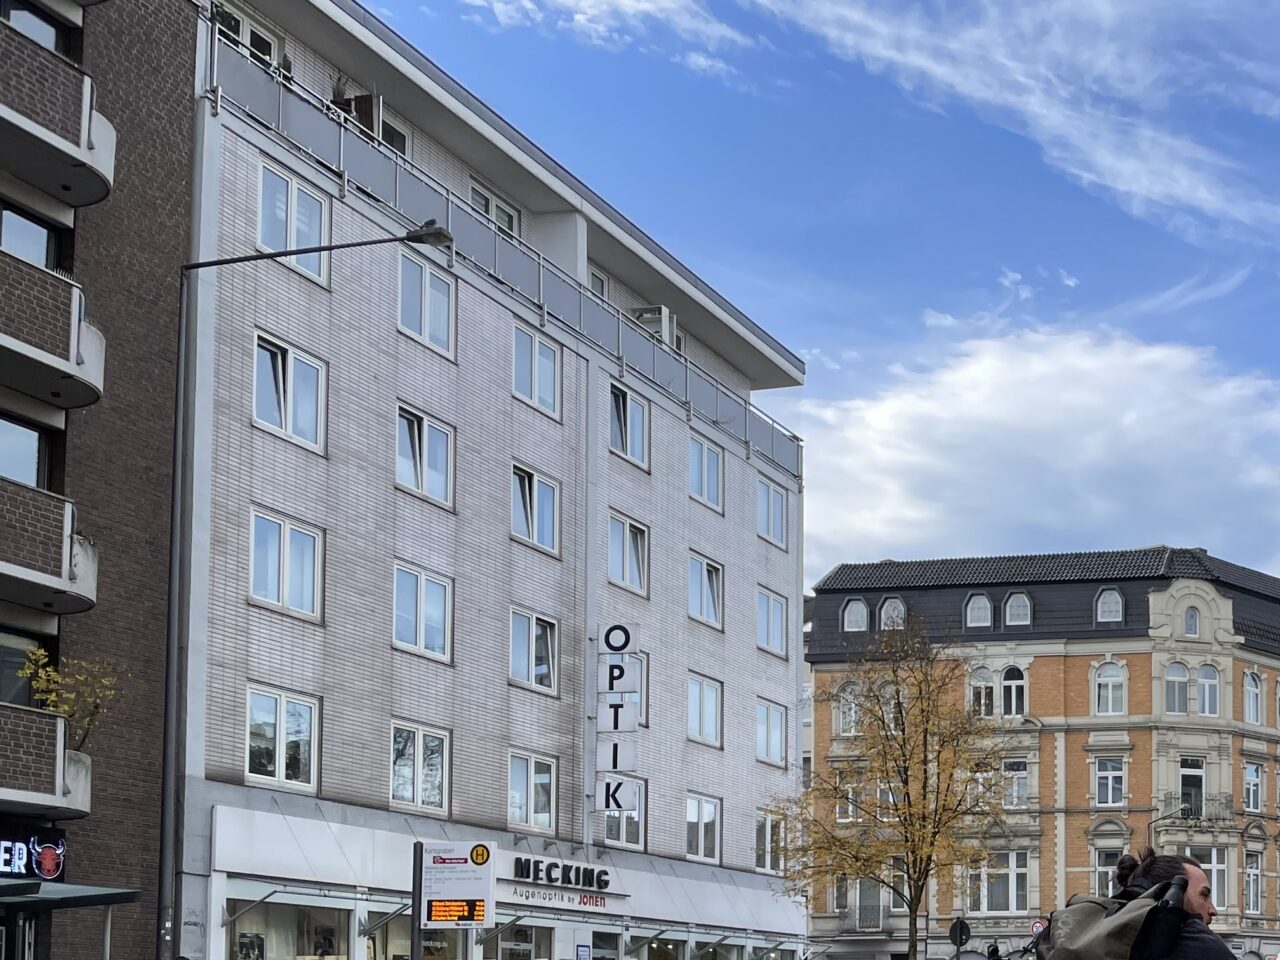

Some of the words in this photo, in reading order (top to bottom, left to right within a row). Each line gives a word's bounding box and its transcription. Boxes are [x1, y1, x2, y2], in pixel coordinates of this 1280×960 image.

[604, 624, 631, 810] OPTIK
[0, 841, 27, 874] ER
[514, 857, 610, 890] MECKING
[513, 887, 564, 903] Augenoptik
